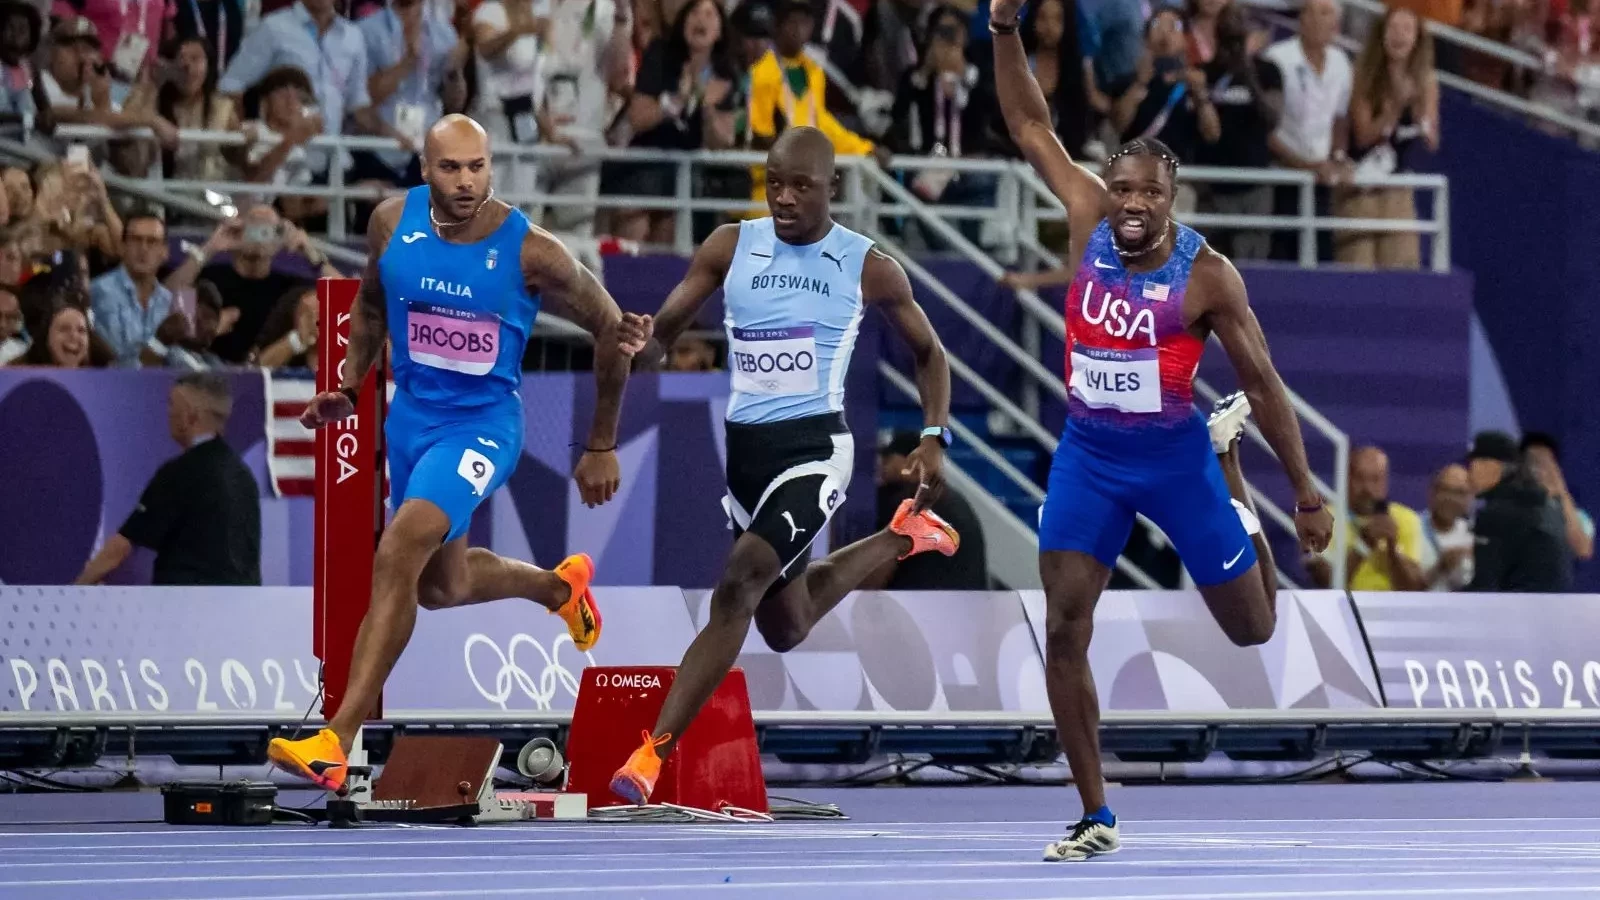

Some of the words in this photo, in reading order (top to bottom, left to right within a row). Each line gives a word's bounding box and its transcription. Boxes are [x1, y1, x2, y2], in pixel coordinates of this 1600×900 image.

[420, 277, 473, 299] ITALIA
[751, 275, 830, 298] BOTSWANA
[1081, 280, 1157, 346] USA
[410, 323, 494, 353] JACOBS
[734, 350, 814, 373] TEBOGO
[1085, 367, 1141, 393] LYLES
[472, 461, 486, 479] 9
[827, 488, 839, 511] 8
[611, 673, 662, 689] OMEGA
